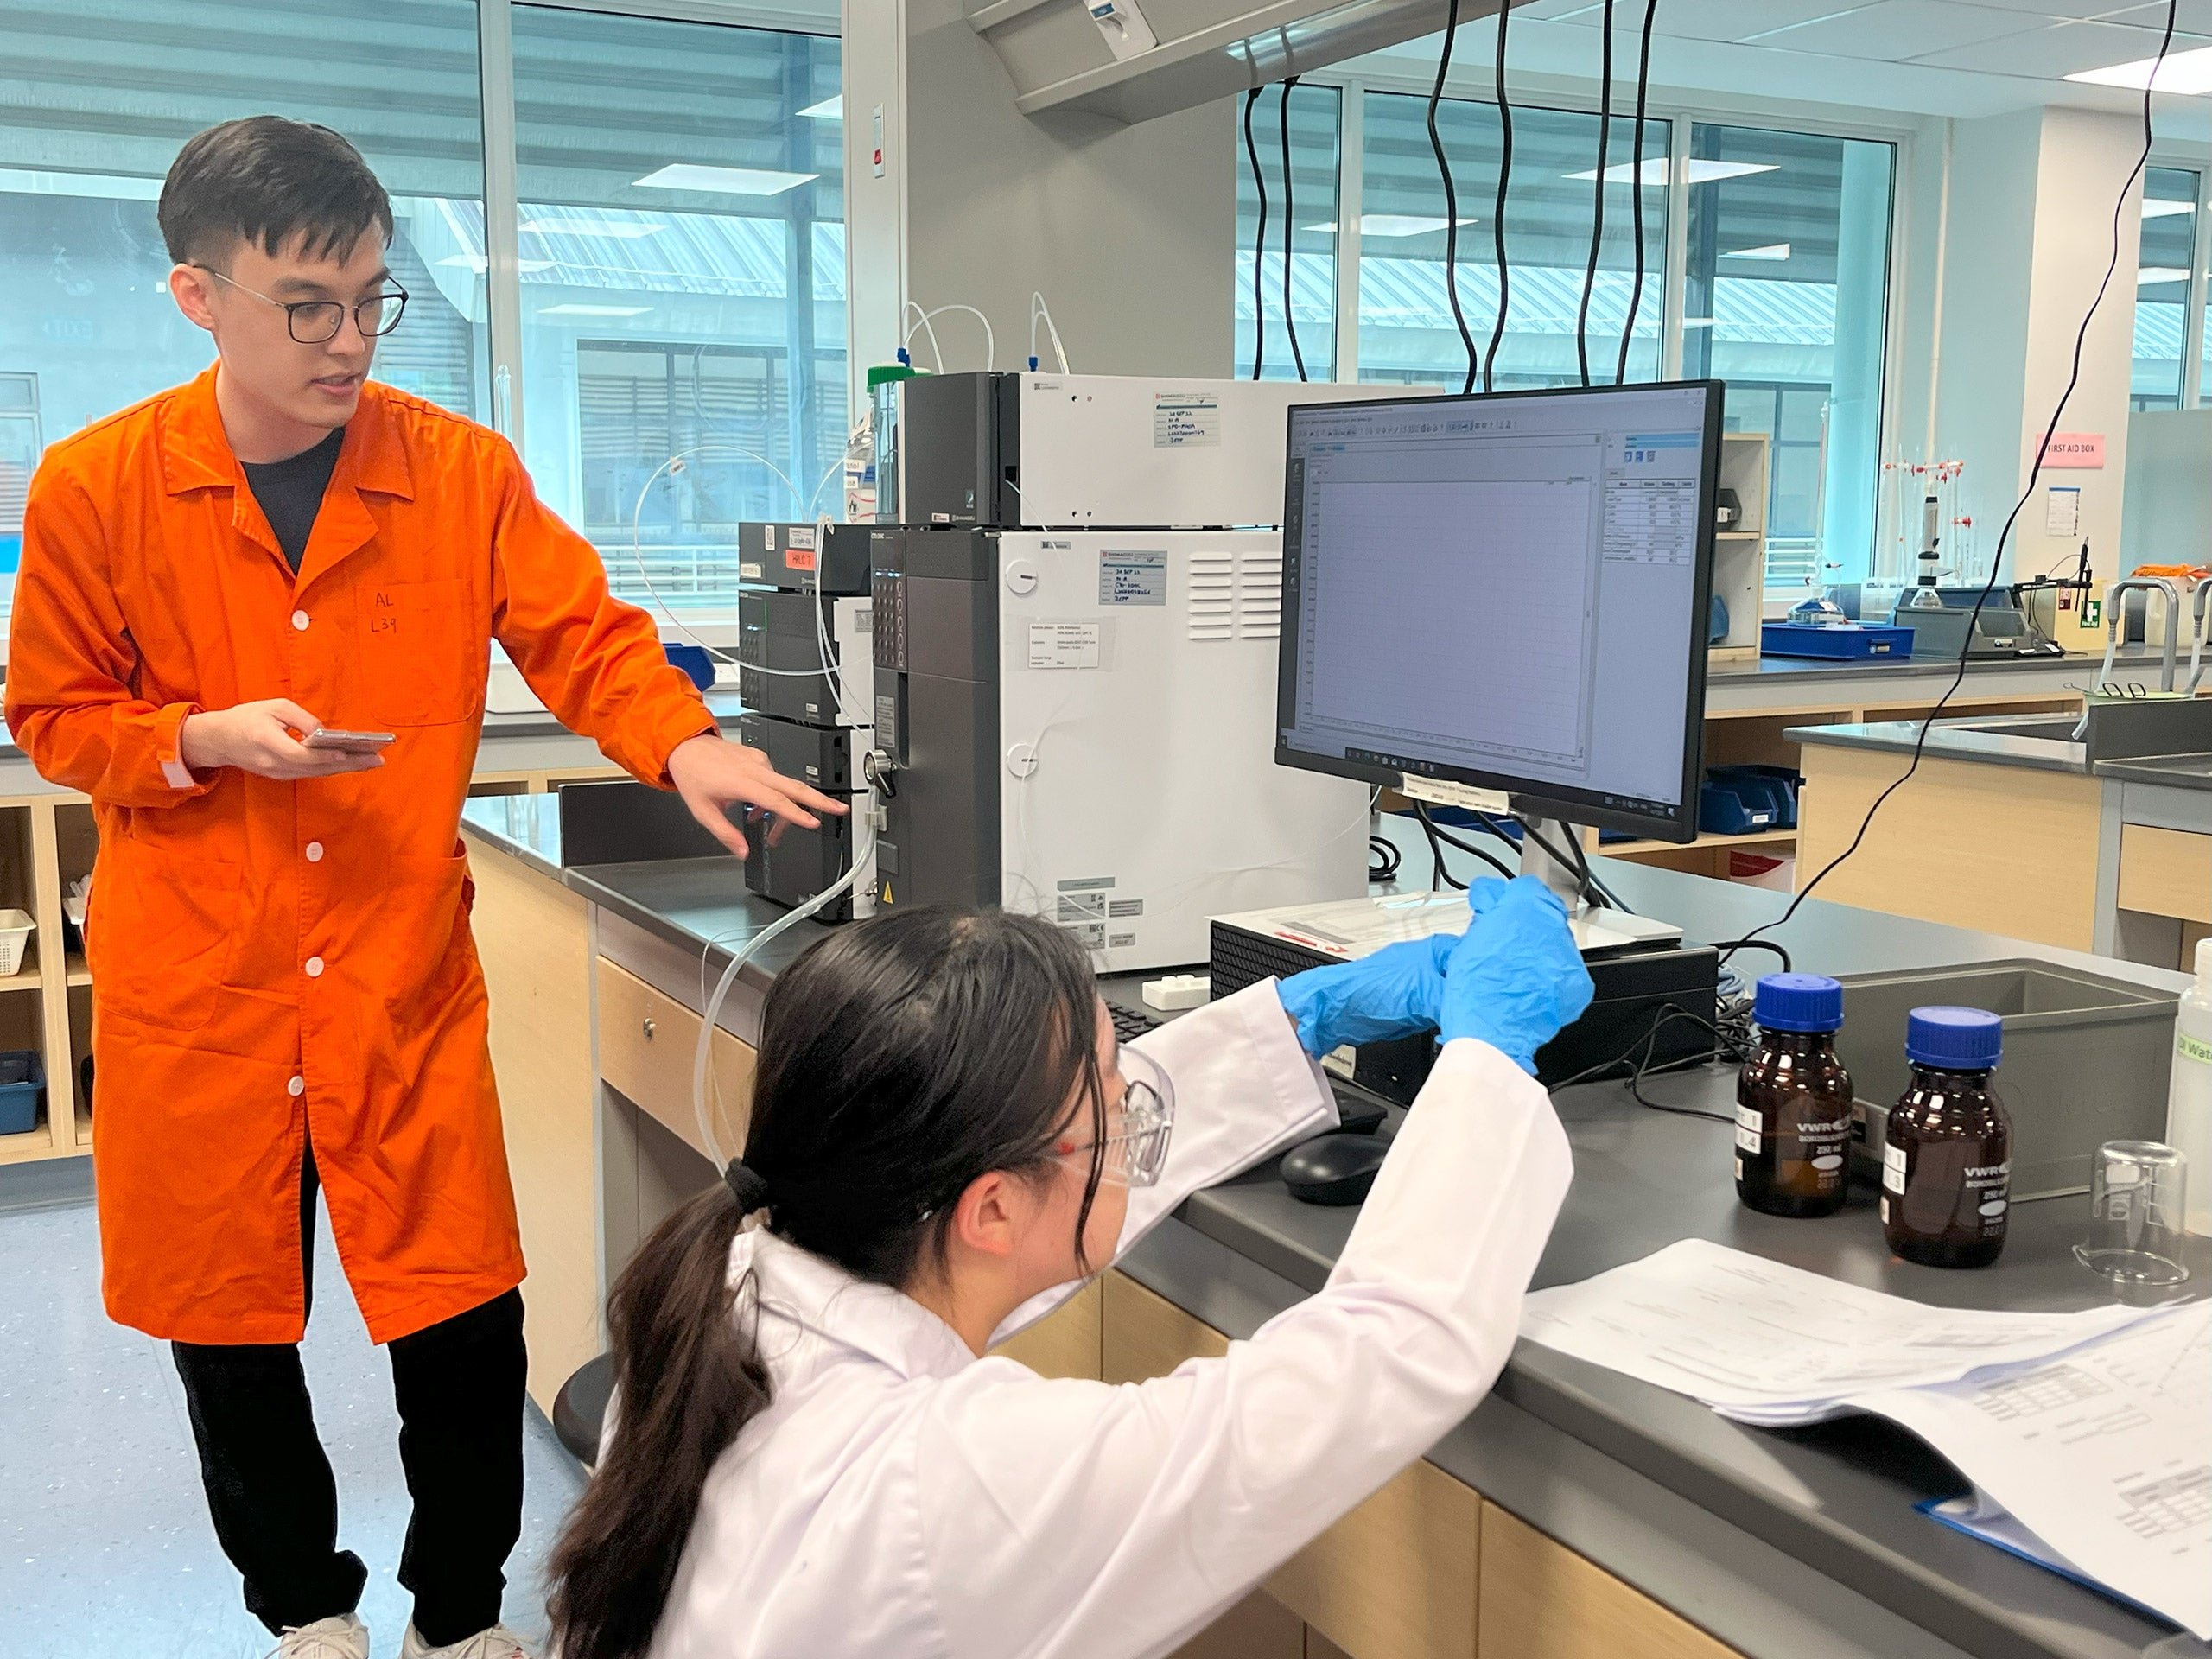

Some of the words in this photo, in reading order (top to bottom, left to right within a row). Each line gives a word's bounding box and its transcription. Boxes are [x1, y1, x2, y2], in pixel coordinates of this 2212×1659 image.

[2047, 444, 2066, 453] FIRST
[2067, 444, 2080, 453] AID
[2081, 444, 2095, 453] BOX
[376, 592, 394, 608] AL
[2188, 1040, 2212, 1060] Wat
[1797, 1122, 1832, 1133] VWR
[1963, 1166, 1999, 1177] VWR
